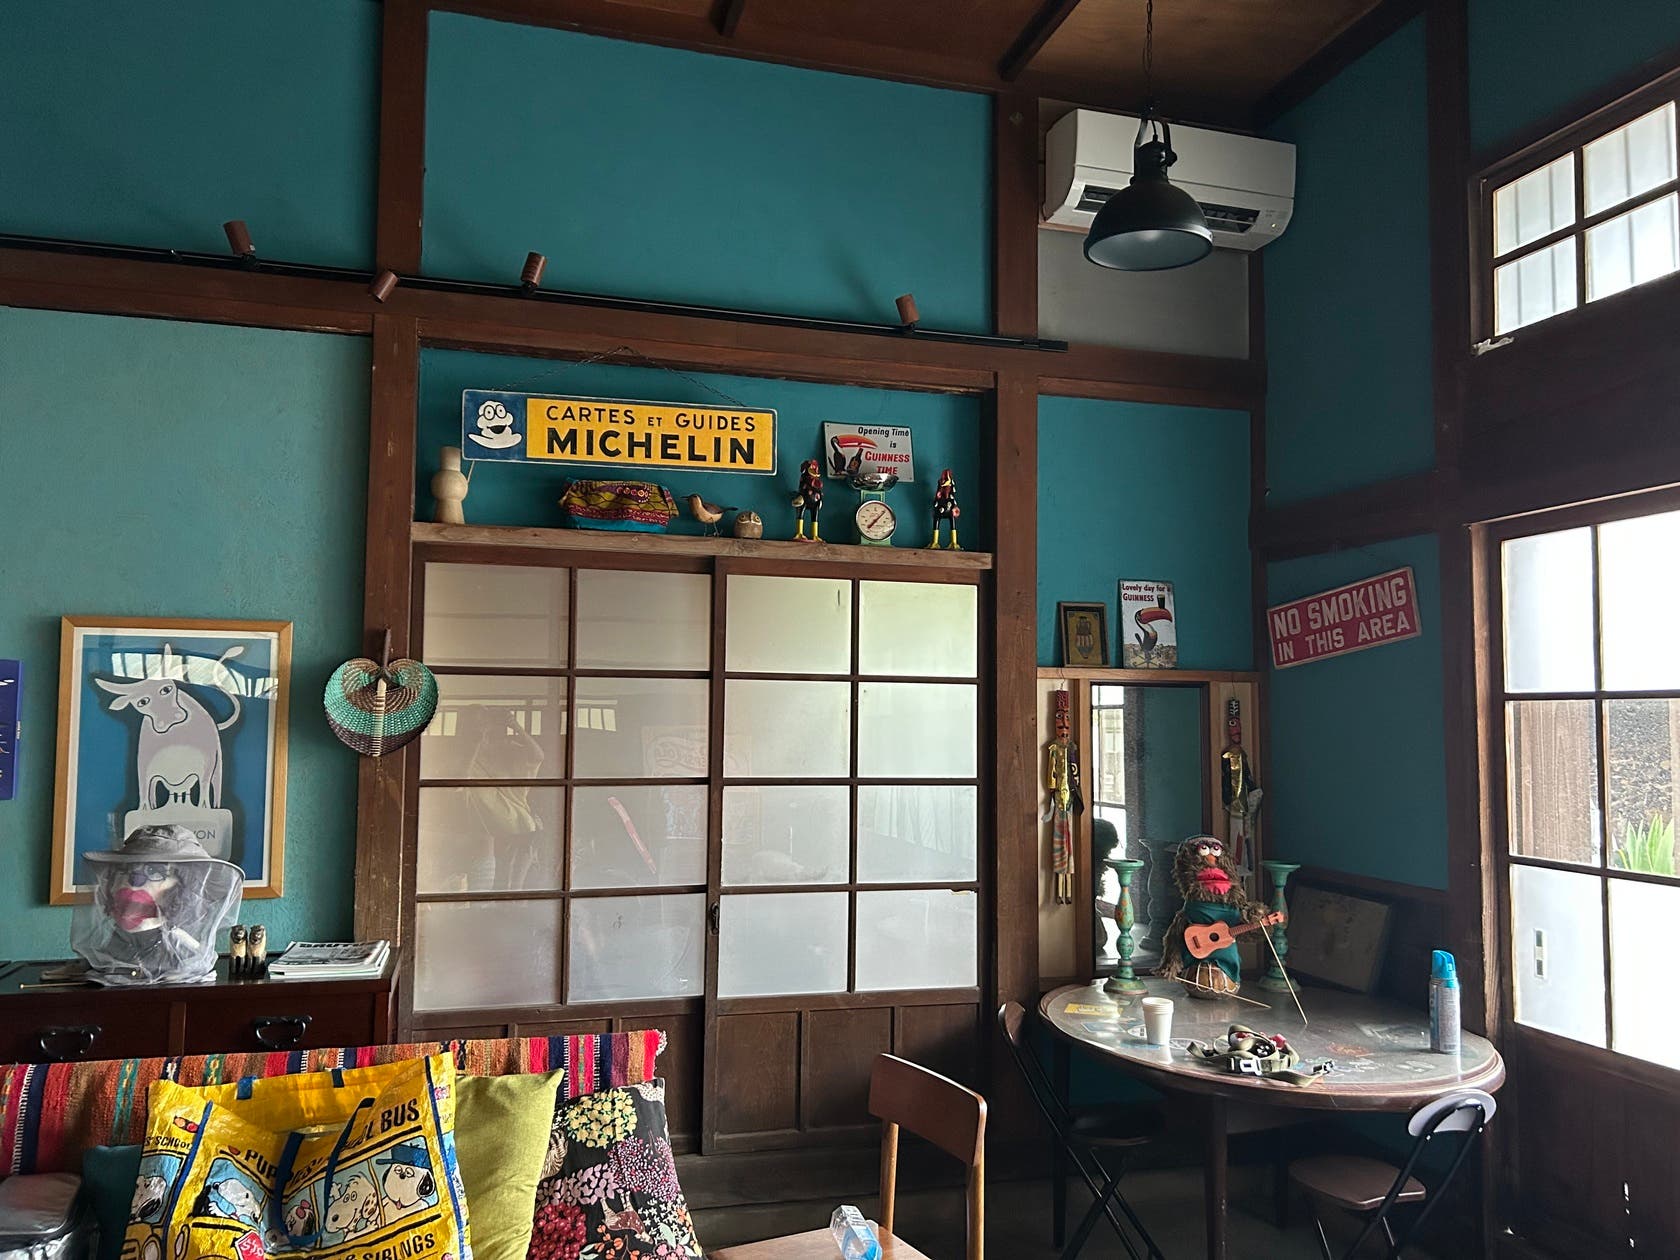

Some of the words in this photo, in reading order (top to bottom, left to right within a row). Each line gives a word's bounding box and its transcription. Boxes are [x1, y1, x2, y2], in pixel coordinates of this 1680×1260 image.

[546, 405, 635, 426] CARTES
[647, 415, 663, 427] ET
[675, 412, 755, 432] GUIDES
[858, 426, 890, 438] Opening
[891, 428, 909, 437] Time
[547, 427, 754, 465] MICHELIN
[865, 451, 910, 463] GUINNESS
[877, 466, 898, 475] TIME
[1122, 584, 1142, 592] Lovely
[1144, 584, 1155, 592] day
[1156, 584, 1166, 592] for
[1123, 593, 1154, 602] GUINNESS
[1274, 608, 1301, 639] NO
[1307, 577, 1407, 630] SMOKING
[1277, 640, 1295, 662] IN
[1304, 628, 1345, 655] THIS
[1358, 611, 1411, 643] AREA
[380, 1098, 420, 1133] BUS
